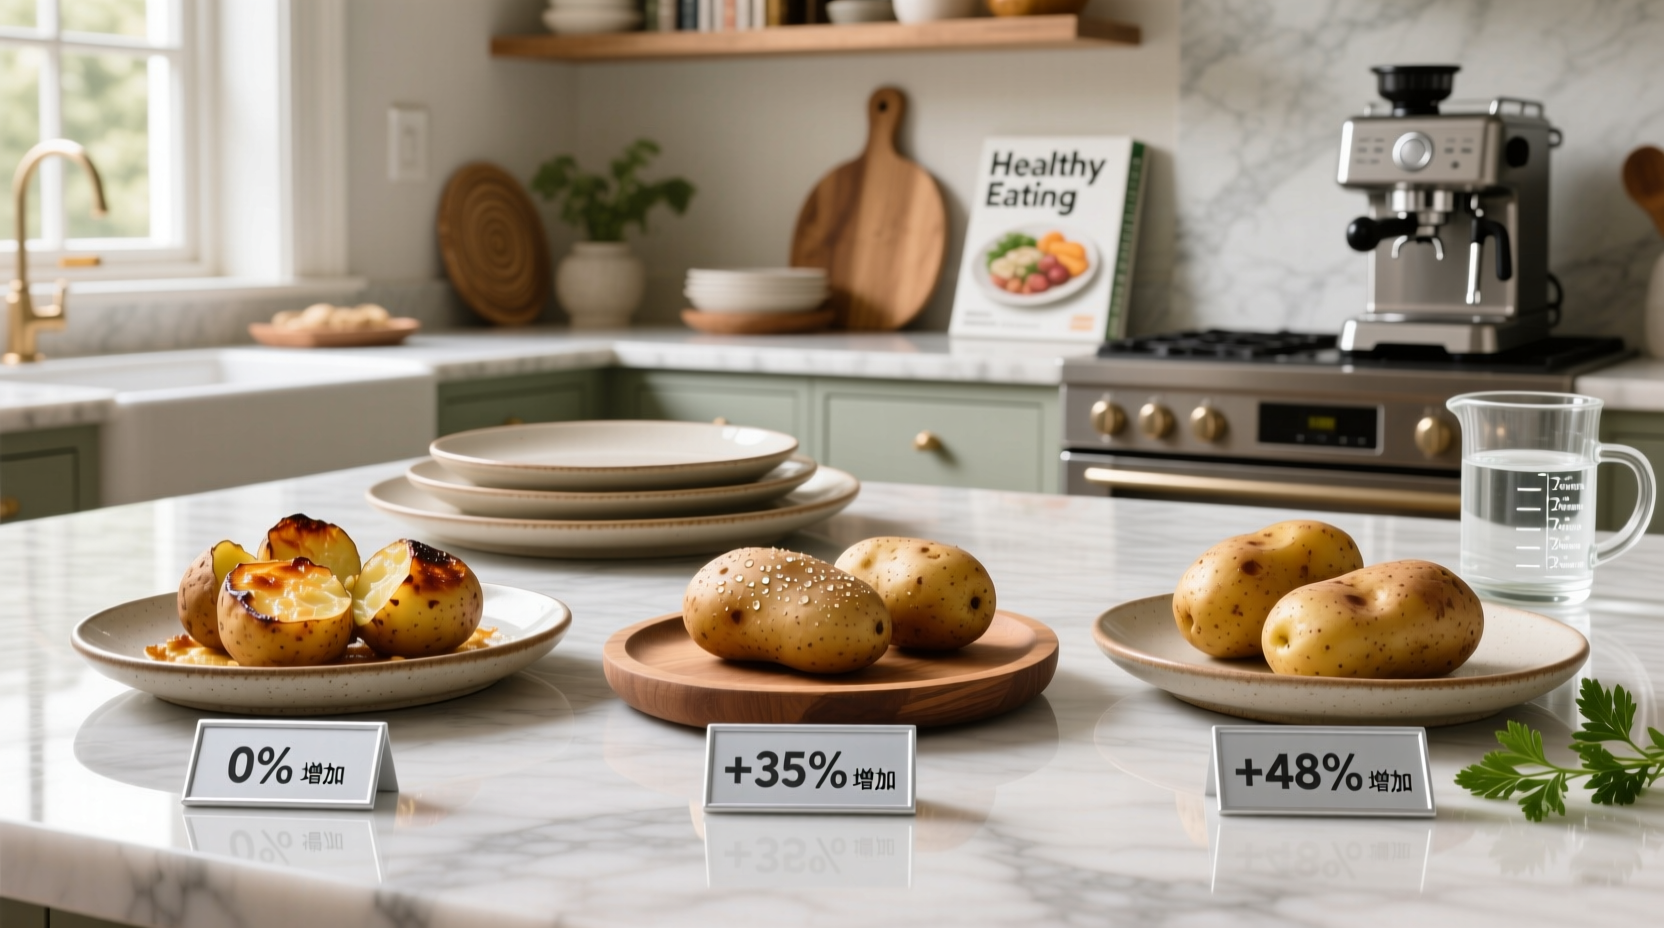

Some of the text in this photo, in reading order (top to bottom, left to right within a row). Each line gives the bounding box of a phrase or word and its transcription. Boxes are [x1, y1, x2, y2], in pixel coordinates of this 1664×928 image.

[990, 150, 1106, 186] Healthy
[985, 181, 1077, 216] Eating
[228, 746, 345, 785] 0% 增加
[725, 750, 896, 791] +35% 增加
[1235, 752, 1413, 793] +48% 增加
